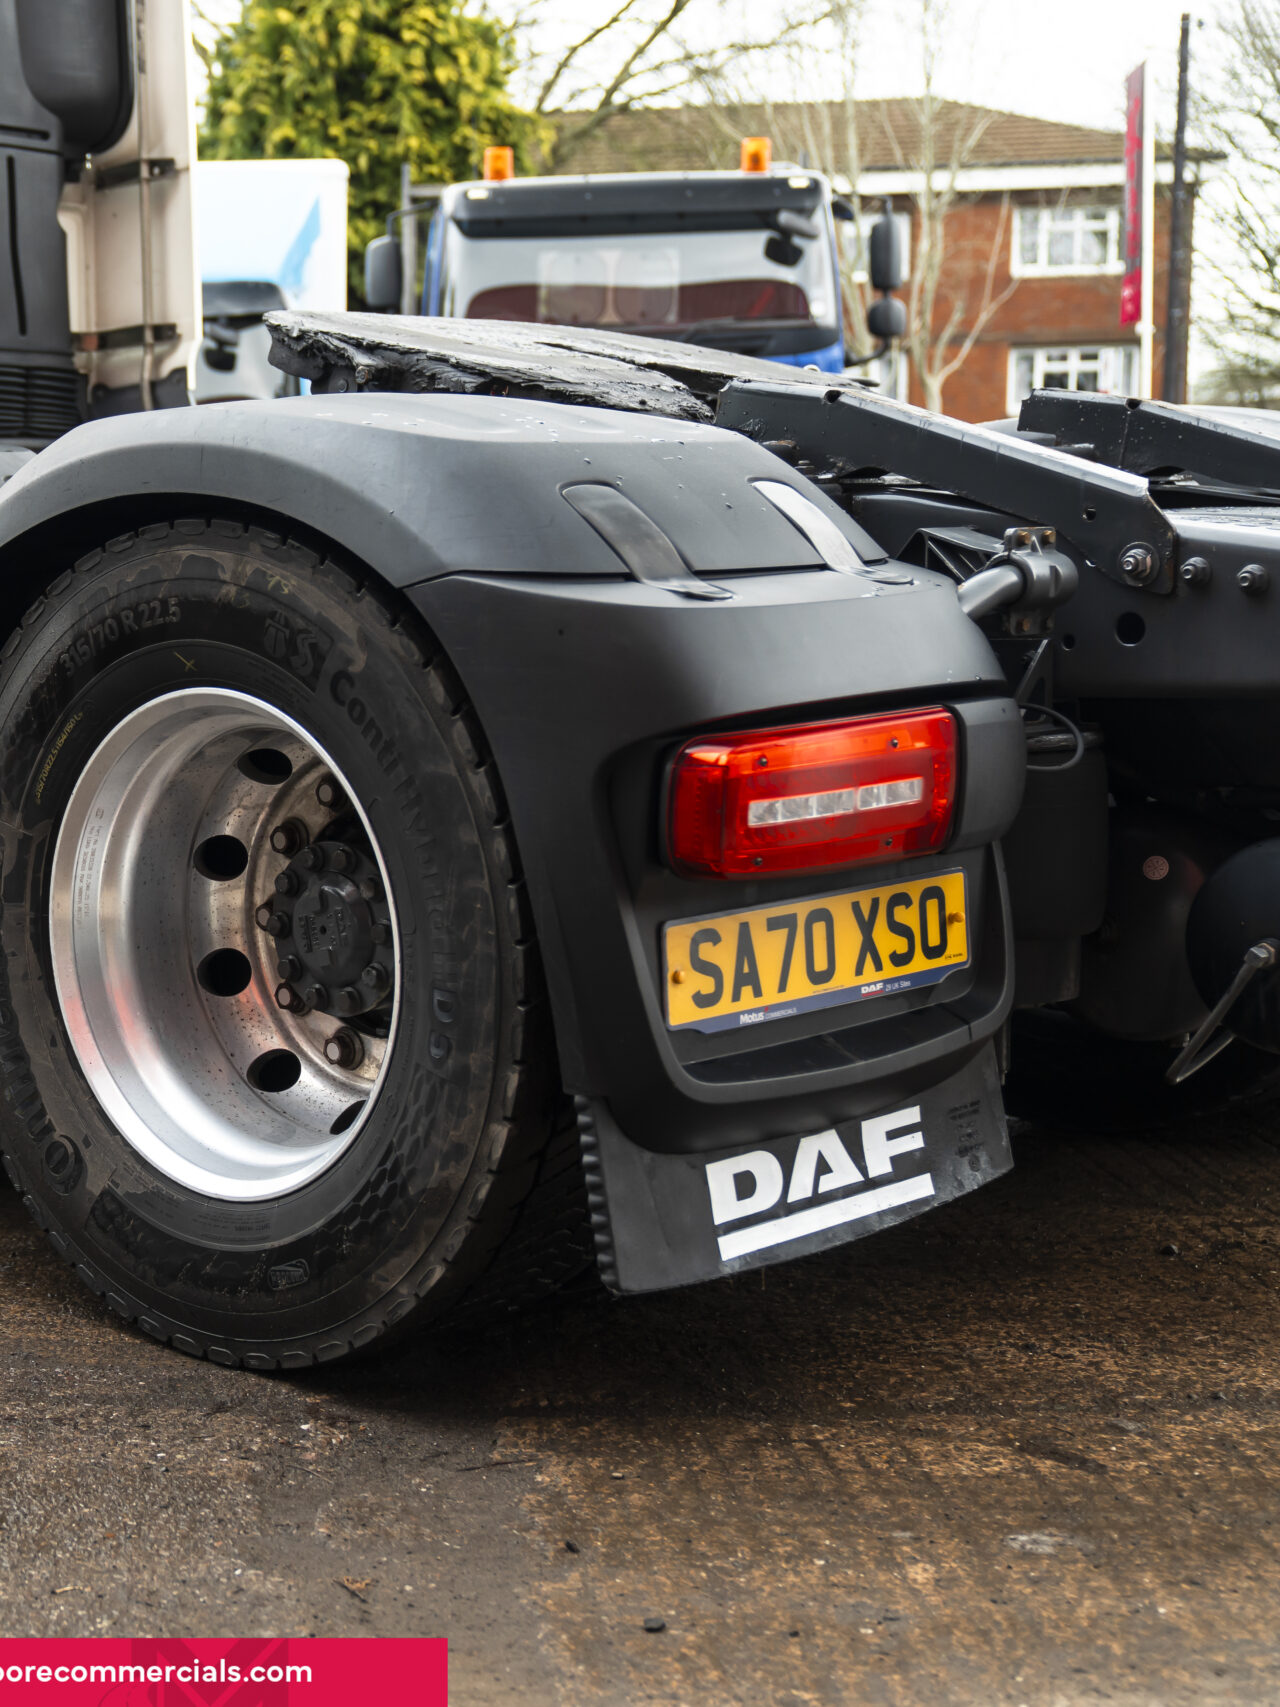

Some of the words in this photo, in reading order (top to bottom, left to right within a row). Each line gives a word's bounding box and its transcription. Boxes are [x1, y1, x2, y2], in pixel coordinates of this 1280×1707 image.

[120, 609, 138, 635] R
[139, 597, 182, 629] 22.5
[330, 670, 401, 776] Conti
[689, 907, 836, 1009] SA70
[851, 885, 948, 977] XSO
[705, 1105, 925, 1226] DAF
